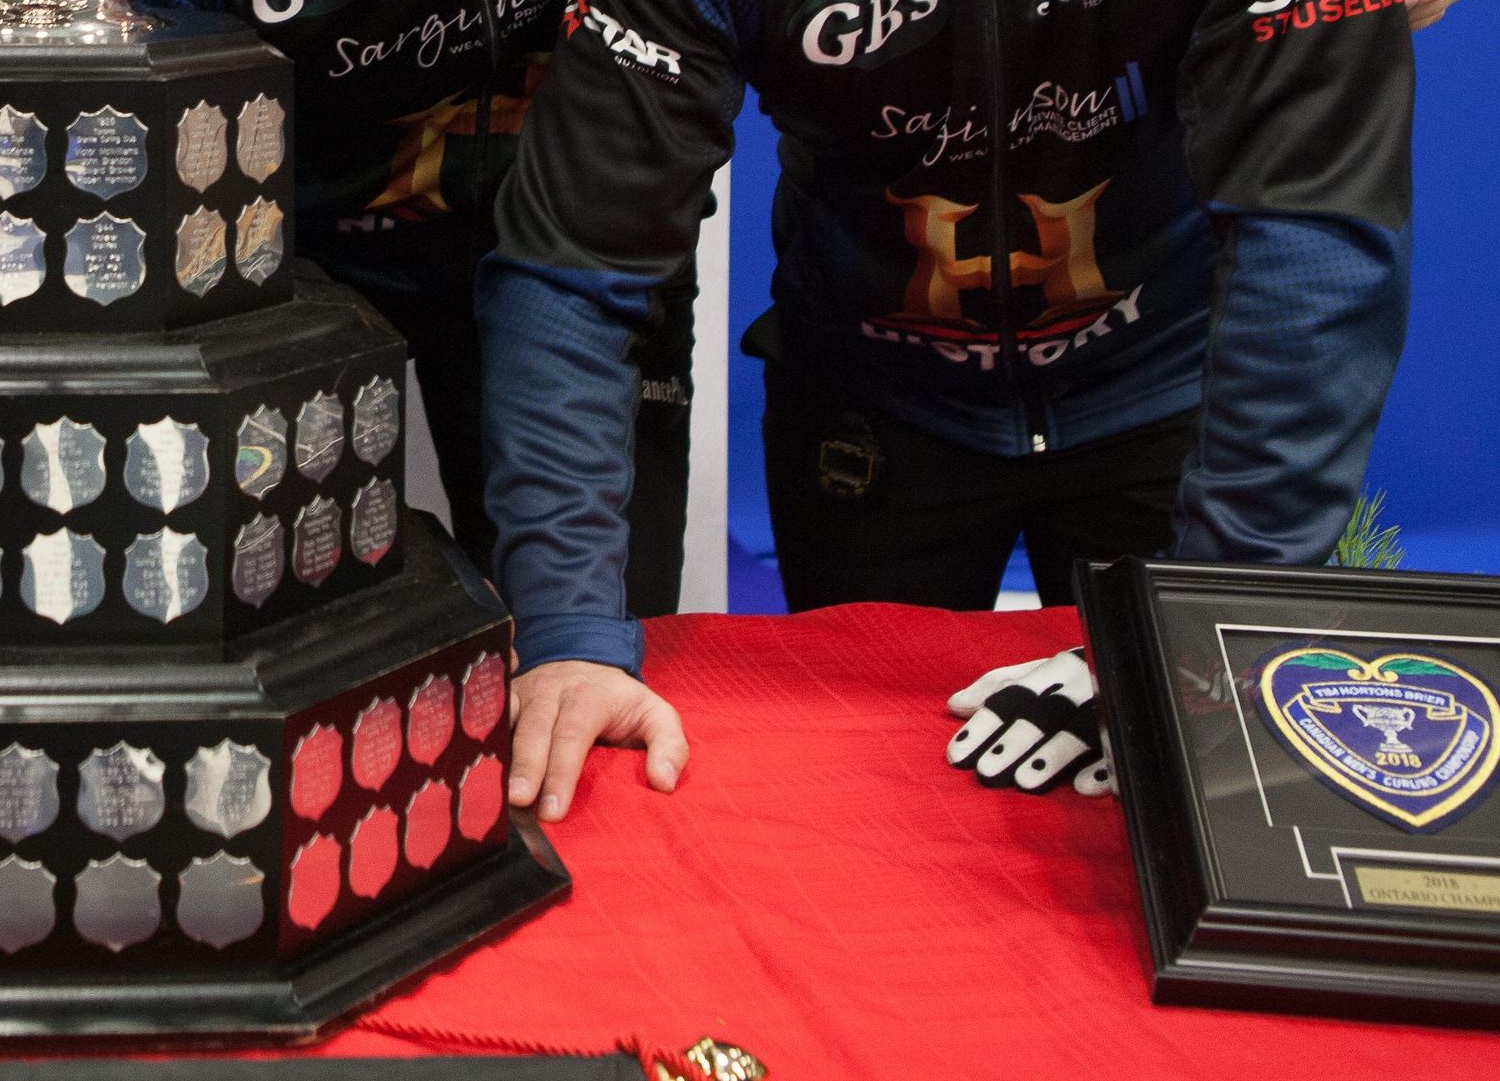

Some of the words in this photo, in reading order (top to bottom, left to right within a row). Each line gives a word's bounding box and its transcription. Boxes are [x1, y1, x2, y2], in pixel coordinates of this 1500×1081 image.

[1341, 686, 1403, 699] HORTONS
[1404, 691, 1446, 706] BRIER
[1299, 717, 1347, 759] CANADIAN
[1375, 751, 1423, 769] 2018
